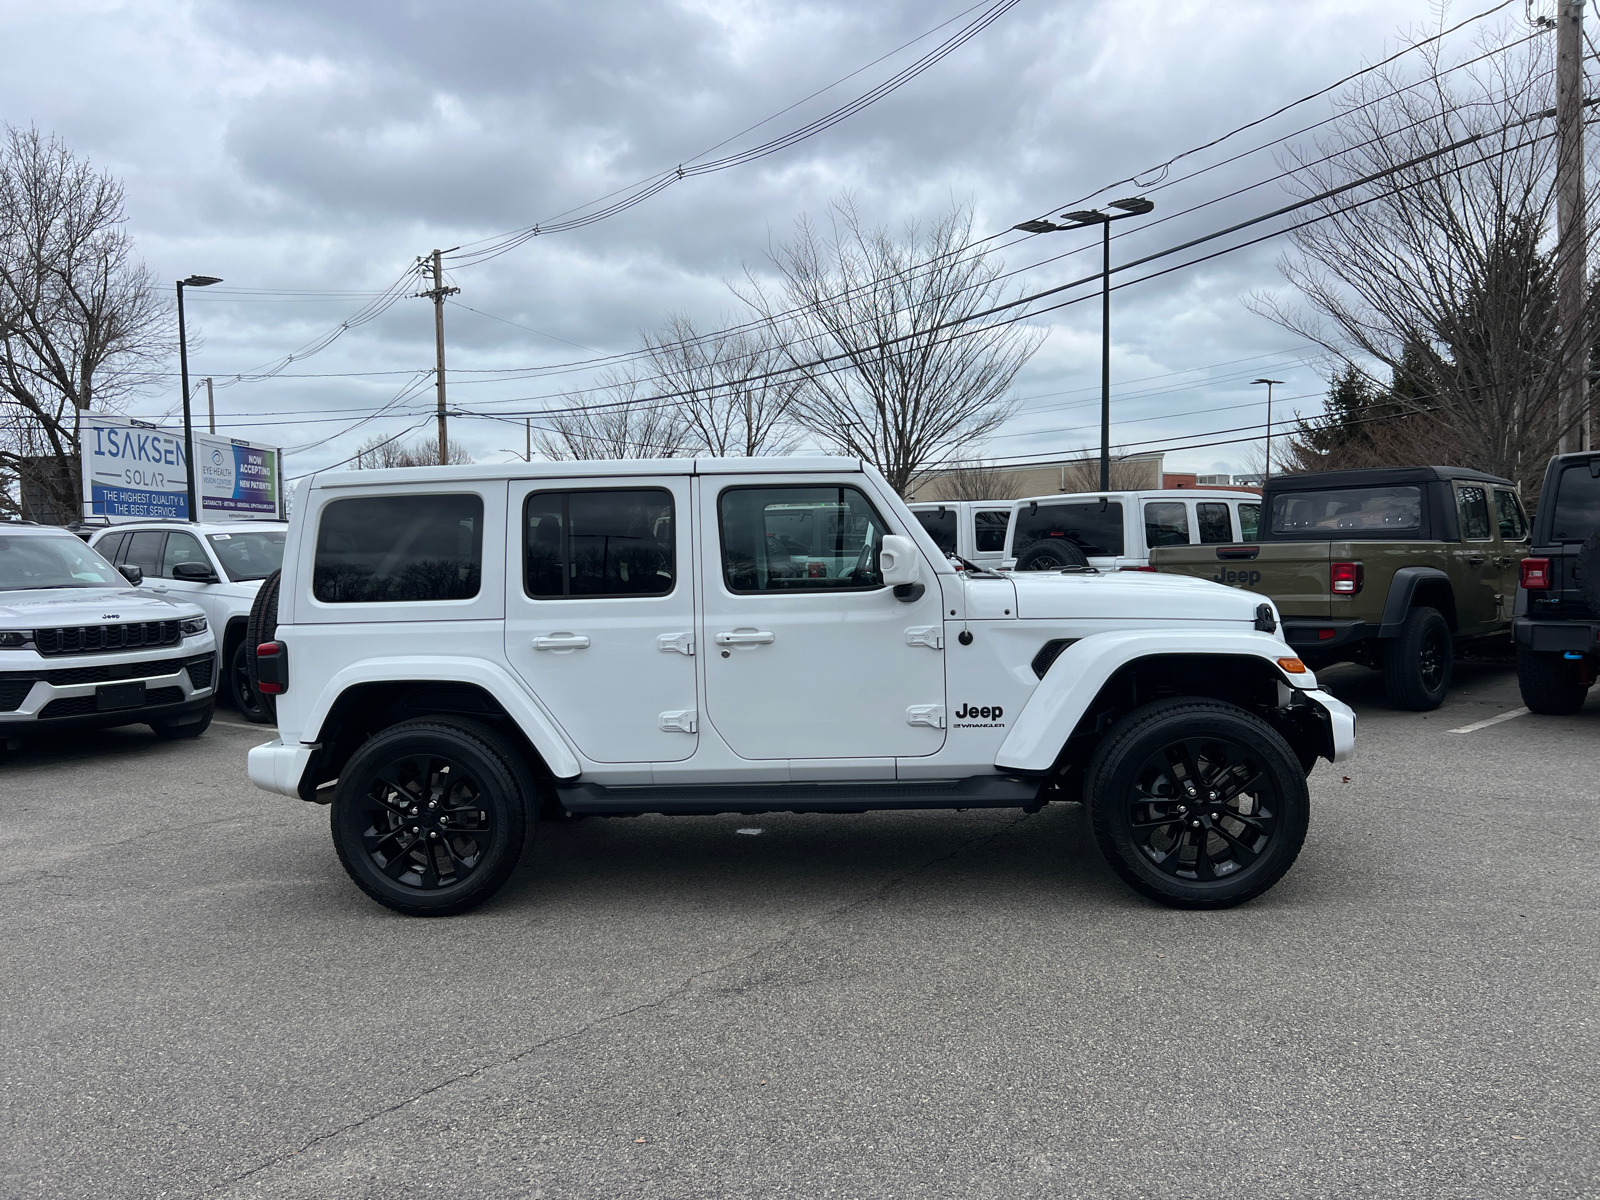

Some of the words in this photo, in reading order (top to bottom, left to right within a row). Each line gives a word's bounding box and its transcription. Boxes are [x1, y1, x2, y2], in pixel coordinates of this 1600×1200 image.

[93, 426, 187, 466] ISAKSEN
[248, 455, 263, 465] NOW
[203, 466, 212, 475] EYE
[213, 467, 232, 477] HEALTH
[240, 464, 271, 476] ACCEPTING
[125, 468, 165, 488] SOLAR
[217, 478, 232, 486] CENTERS
[240, 480, 251, 488] NEW
[103, 490, 118, 502] THE
[120, 492, 150, 504] HIGHEST
[151, 494, 178, 506] QUALITY
[180, 496, 185, 506] &
[114, 503, 129, 515] THE
[130, 504, 148, 515] BEST
[149, 505, 177, 517] SERVICE
[1214, 567, 1261, 586] Jeep
[955, 703, 1003, 721] Jeep
